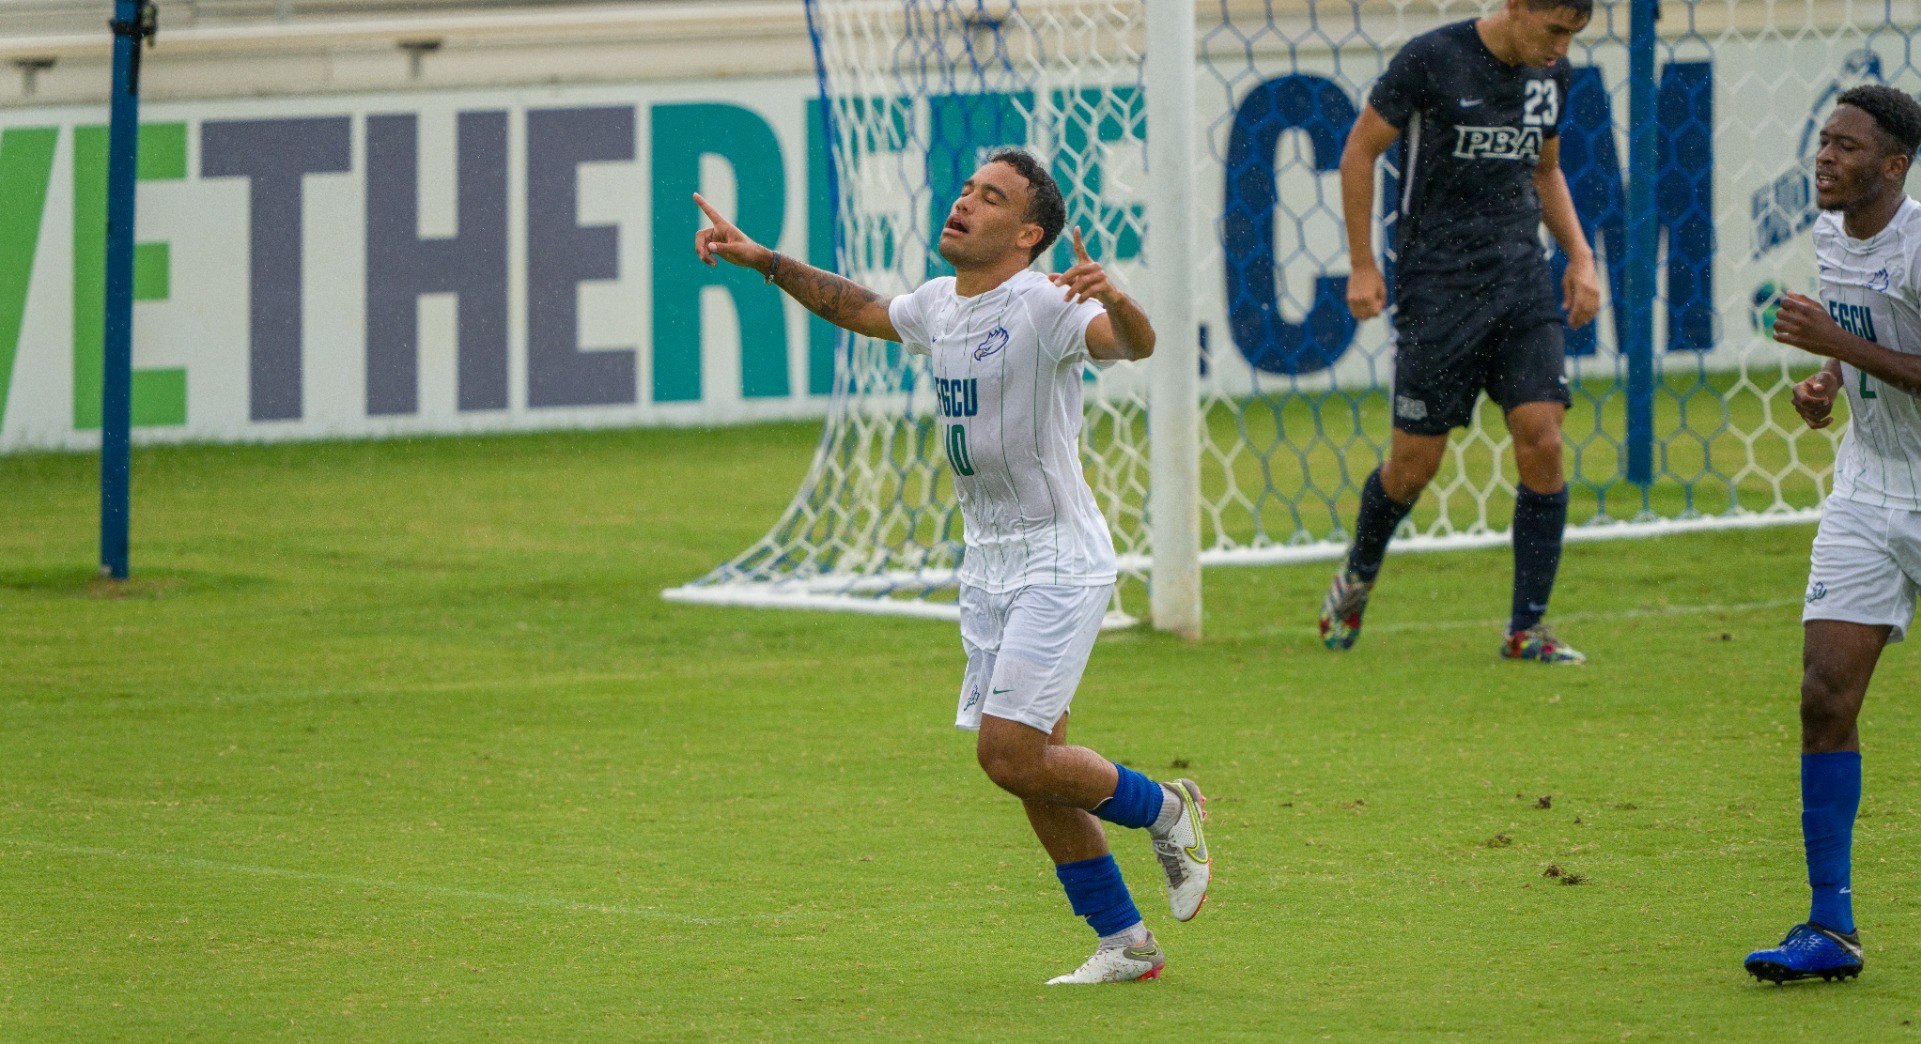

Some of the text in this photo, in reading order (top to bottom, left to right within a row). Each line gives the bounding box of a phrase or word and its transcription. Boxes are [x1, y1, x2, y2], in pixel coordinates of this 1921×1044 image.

[1523, 78, 1560, 126] 23
[1451, 125, 1543, 160] PBA
[946, 423, 975, 476] 10
